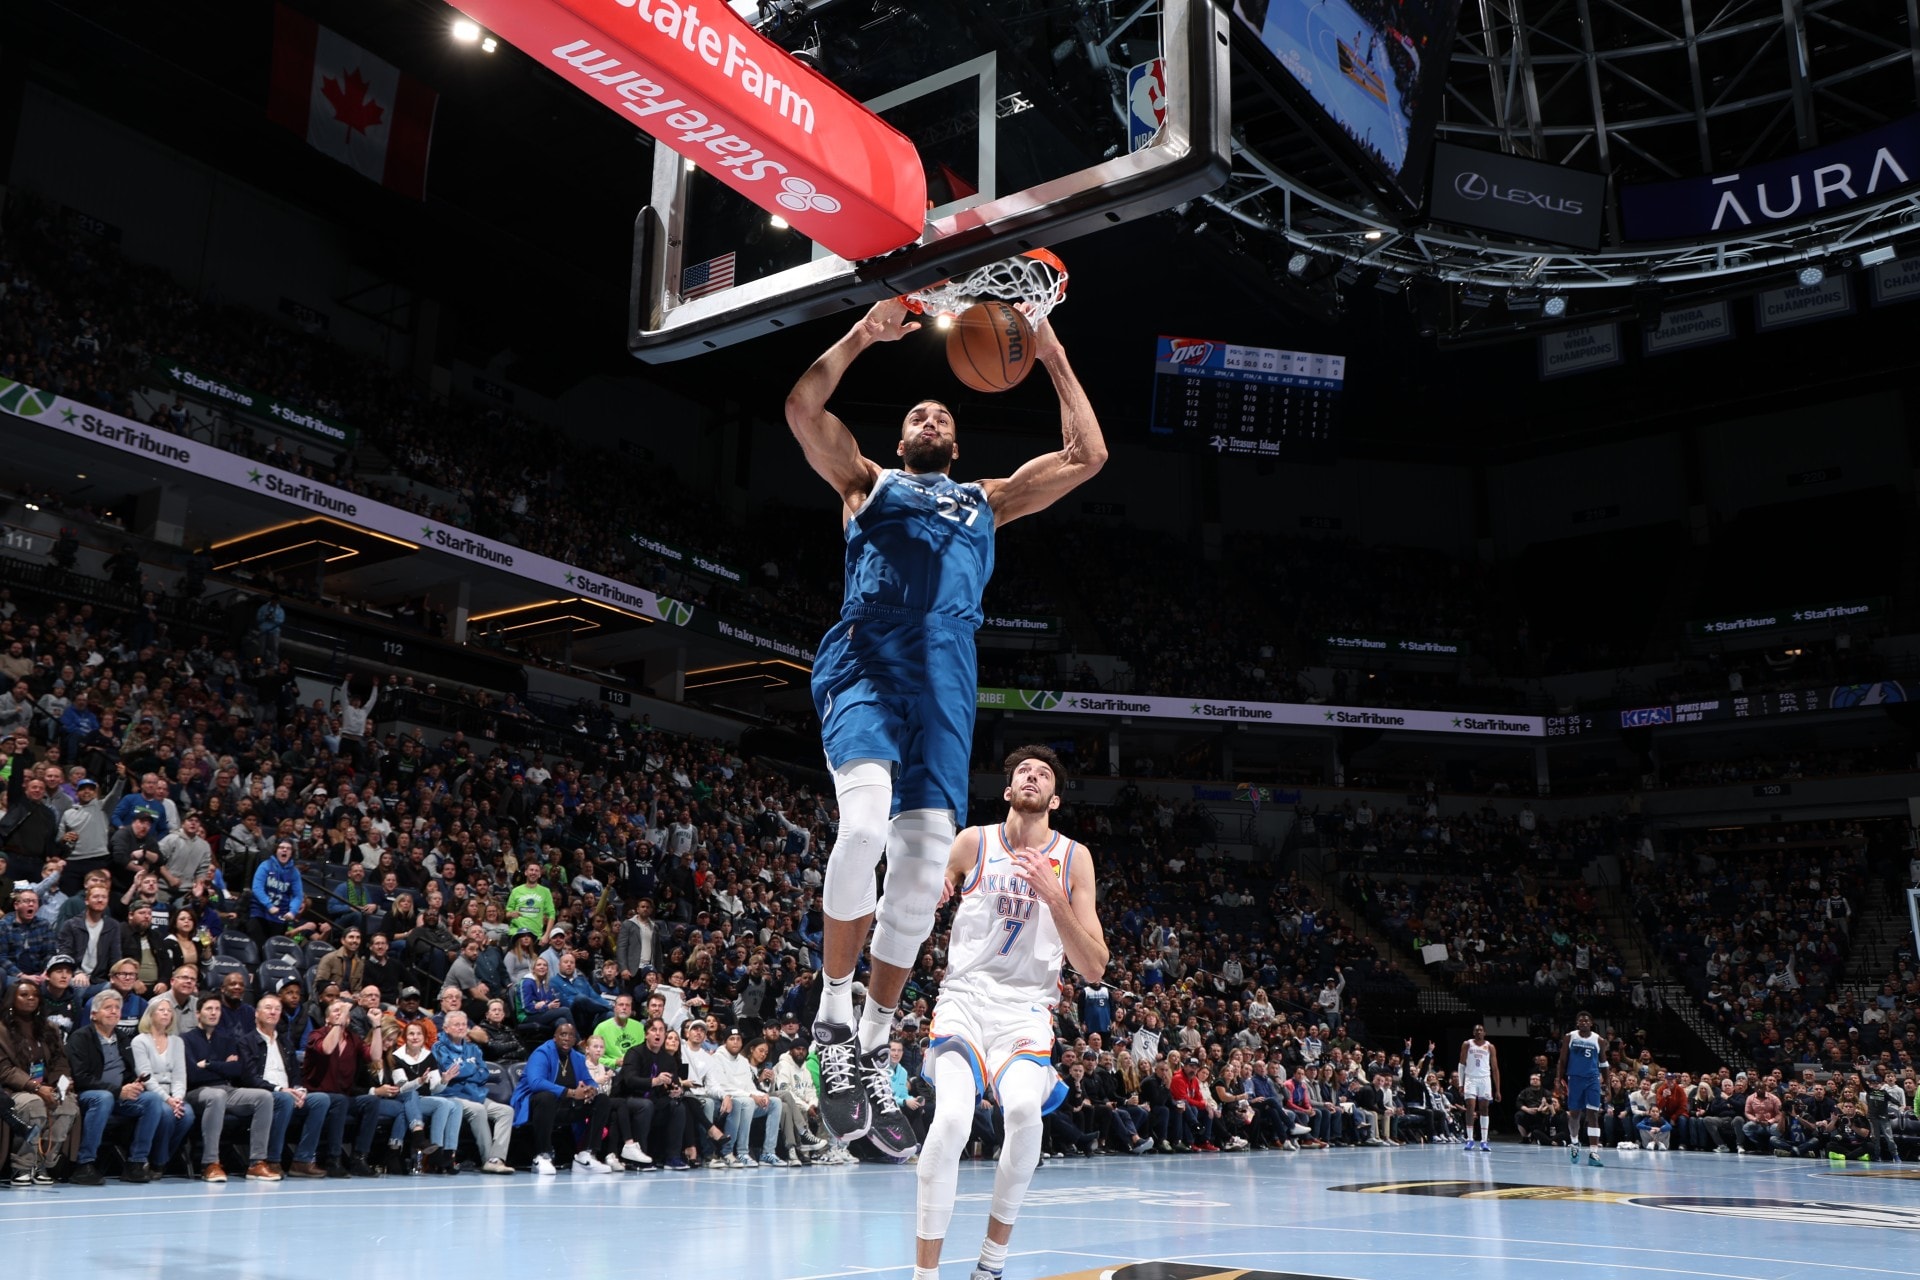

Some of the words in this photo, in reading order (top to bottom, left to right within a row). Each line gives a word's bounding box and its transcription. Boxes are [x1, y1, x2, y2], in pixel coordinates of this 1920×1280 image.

[1492, 184, 1583, 215] LEXUS
[1901, 259, 1920, 272] WN
[1884, 273, 1920, 289] CHAM
[1784, 285, 1822, 299] WNBA
[1768, 292, 1841, 315] CHAMPIONS
[1669, 310, 1703, 325] WNBA
[1654, 317, 1722, 340] CHAMPIONS
[1563, 336, 1595, 350] WNBA
[1170, 345, 1205, 363] OKC
[1550, 343, 1612, 365] CHAMPIONS
[183, 371, 253, 407] StarTribune
[1187, 378, 1200, 386] 2/2
[1244, 383, 1257, 392] 0/0
[1186, 389, 1200, 397] 2/2
[1243, 394, 1257, 403] 0/0
[1187, 399, 1199, 407] 1/2
[1242, 404, 1256, 412] 0/0
[281, 406, 346, 440] StarTribune
[1183, 419, 1197, 427] 0/2
[1240, 425, 1254, 433] 0/0
[1241, 414, 1255, 423] 0/0
[82, 414, 190, 463] StarTribune
[1229, 436, 1258, 449] Treasure
[1259, 439, 1280, 451] Island
[265, 474, 357, 516] StarTribune
[936, 497, 979, 527] 27
[7, 532, 33, 550] 111
[436, 530, 513, 567] StarTribune
[638, 536, 682, 561] StarTribune
[699, 557, 740, 582] StarTribune
[577, 575, 643, 608] StarTribune
[1804, 603, 1869, 621] StarTribune
[995, 618, 1048, 629] StarTribune
[1716, 615, 1776, 632] StarTribune
[383, 641, 404, 656] 112
[718, 621, 734, 636] We
[734, 628, 754, 643] take
[755, 636, 772, 650] you
[773, 640, 799, 657] inside
[801, 649, 815, 662] the
[1408, 642, 1457, 653] StarTribune
[608, 691, 624, 703] 113
[1080, 698, 1151, 712] StarTribune
[1203, 705, 1272, 719] StarTribune
[1337, 712, 1404, 726] StarTribune
[1547, 717, 1565, 726] CHI
[1568, 716, 1580, 725] 35
[1585, 719, 1592, 728] 2
[1621, 706, 1672, 728] KFAN
[1464, 719, 1530, 732] StarTribune
[1547, 727, 1566, 736] BOS
[1568, 726, 1580, 735] 51
[1066, 780, 1076, 790] 16
[1763, 785, 1781, 795] 120
[981, 874, 1041, 900] OKLAH
[997, 896, 1034, 919] CITY
[998, 918, 1025, 956] 7
[1143, 1041, 1150, 1050] 5
[1584, 1049, 1592, 1058] 5
